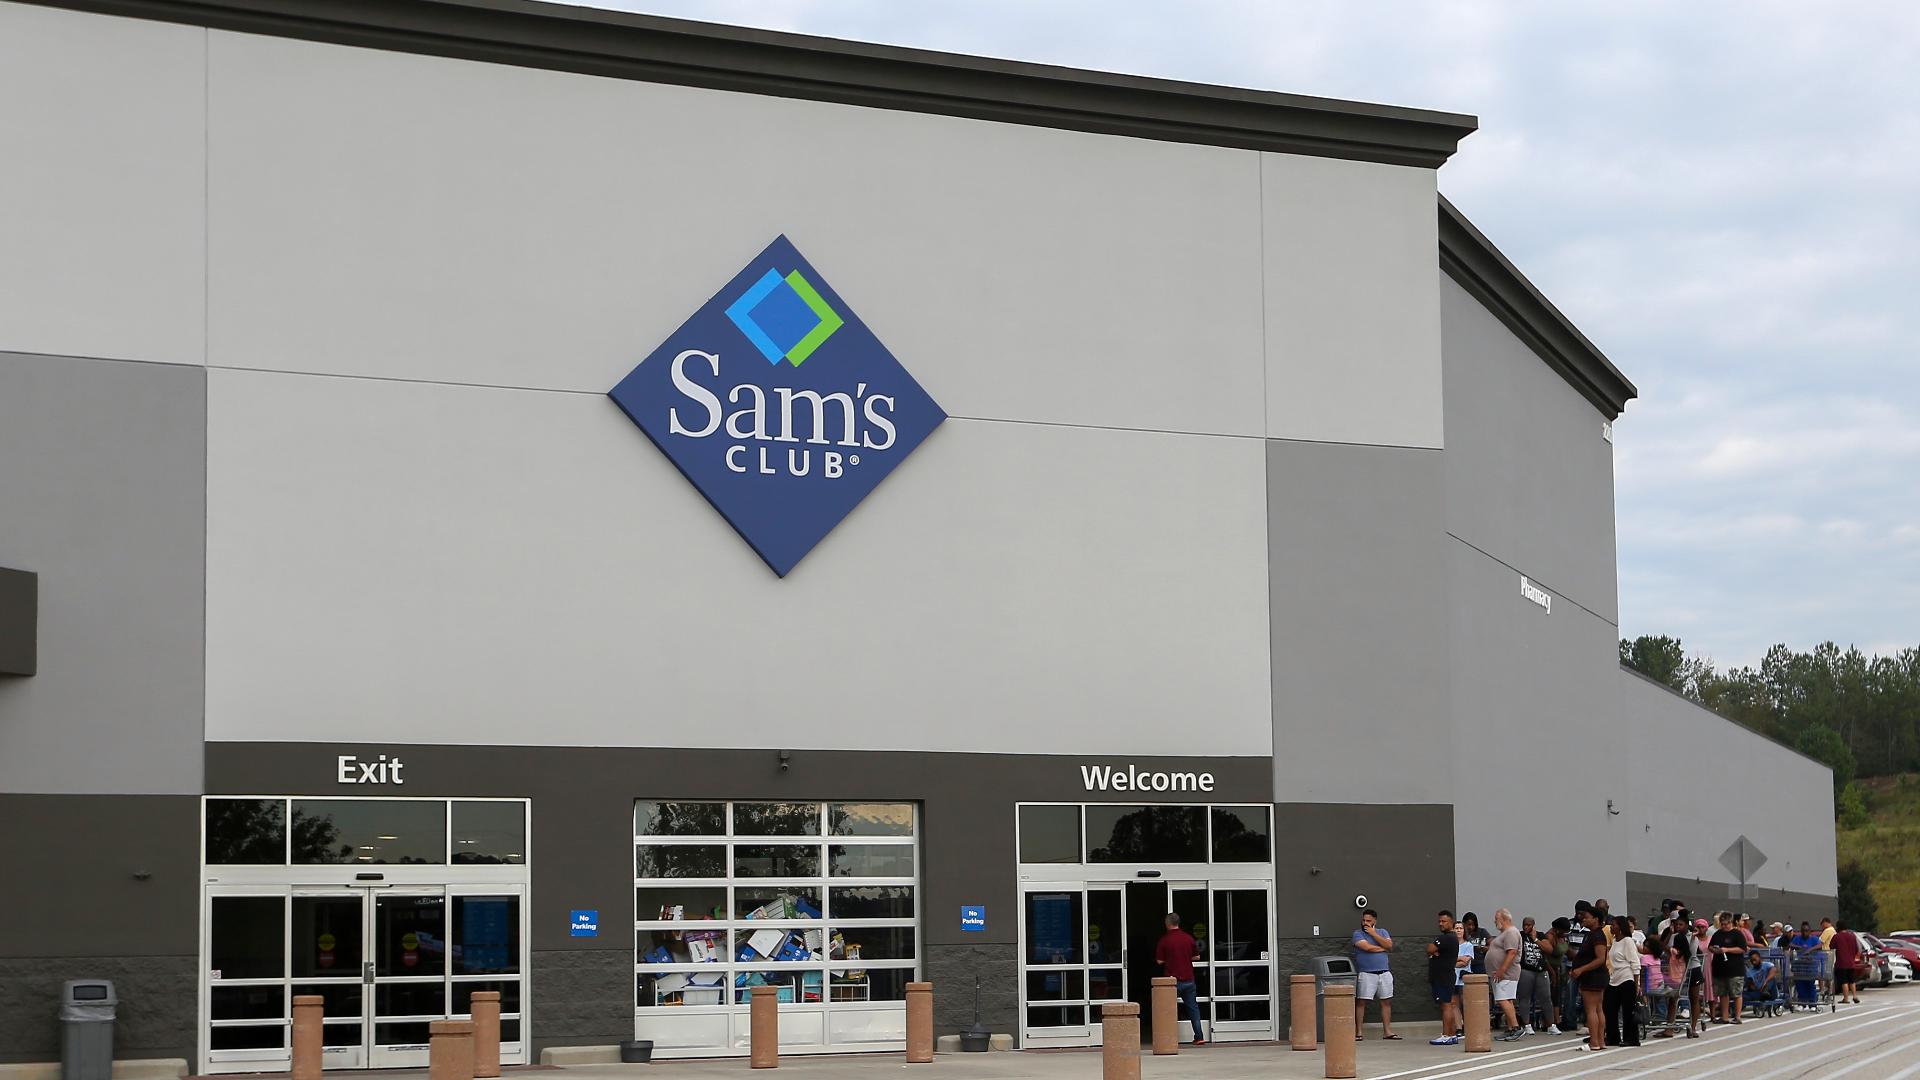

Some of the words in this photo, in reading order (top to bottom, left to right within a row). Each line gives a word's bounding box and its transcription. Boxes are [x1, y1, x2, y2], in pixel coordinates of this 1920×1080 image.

[669, 349, 897, 451] Sam's
[1520, 575, 1552, 615] Pharmacy
[338, 754, 404, 784] Exit
[1080, 764, 1215, 792] Welcome
[571, 923, 597, 931] Parking
